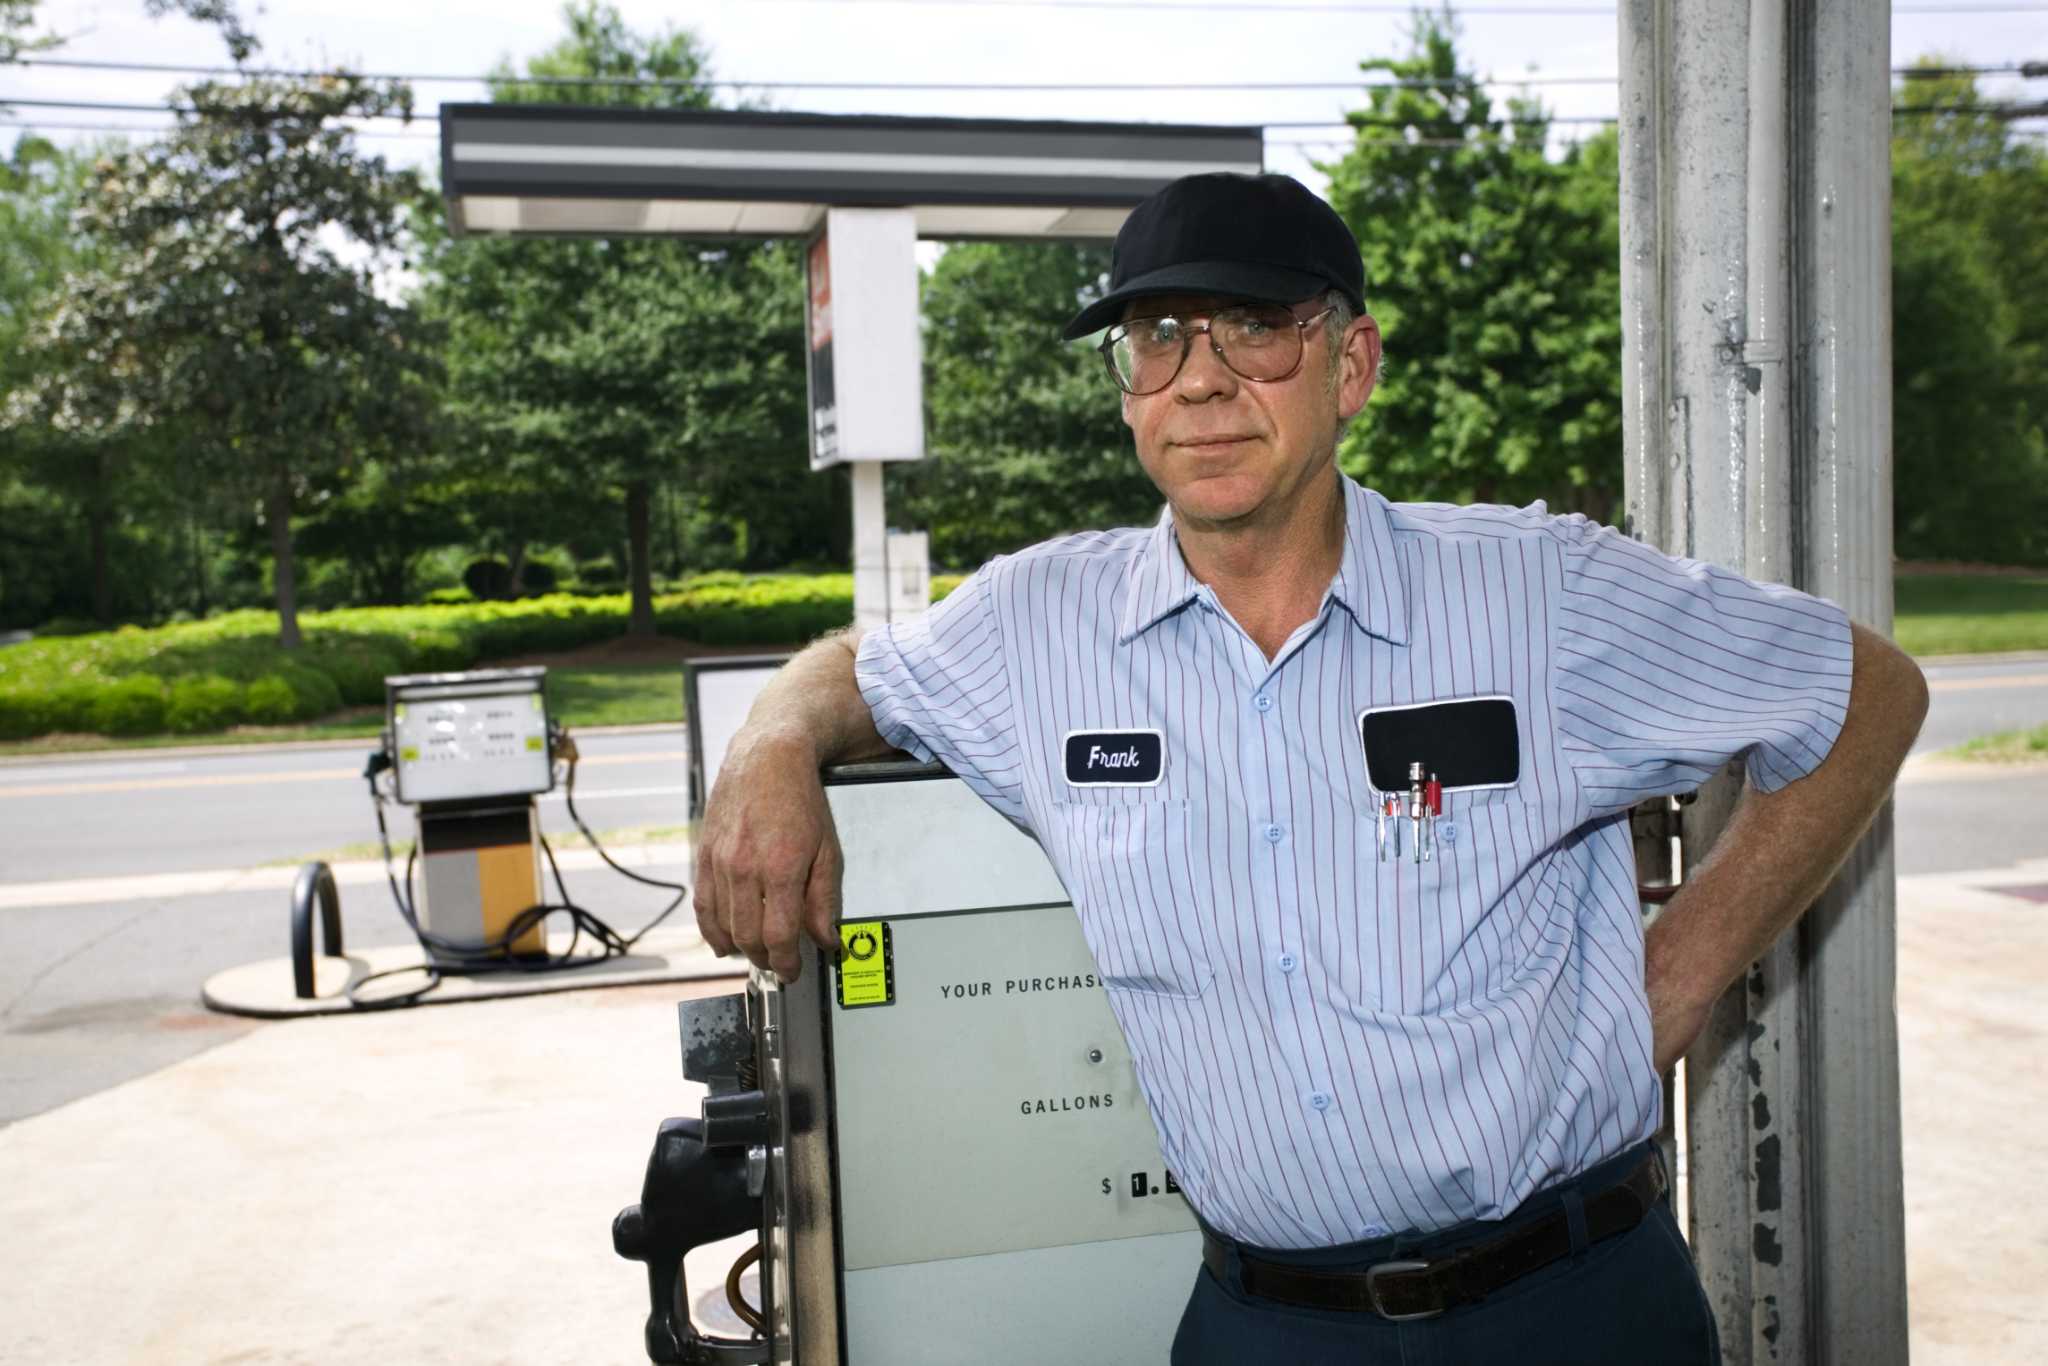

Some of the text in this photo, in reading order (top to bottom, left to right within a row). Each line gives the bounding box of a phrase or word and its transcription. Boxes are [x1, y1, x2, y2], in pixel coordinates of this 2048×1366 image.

[1086, 745, 1140, 769] Frank
[941, 982, 992, 999] YOUR
[1021, 1094, 1114, 1114] GALLONS
[1102, 1177, 1112, 1195] $
